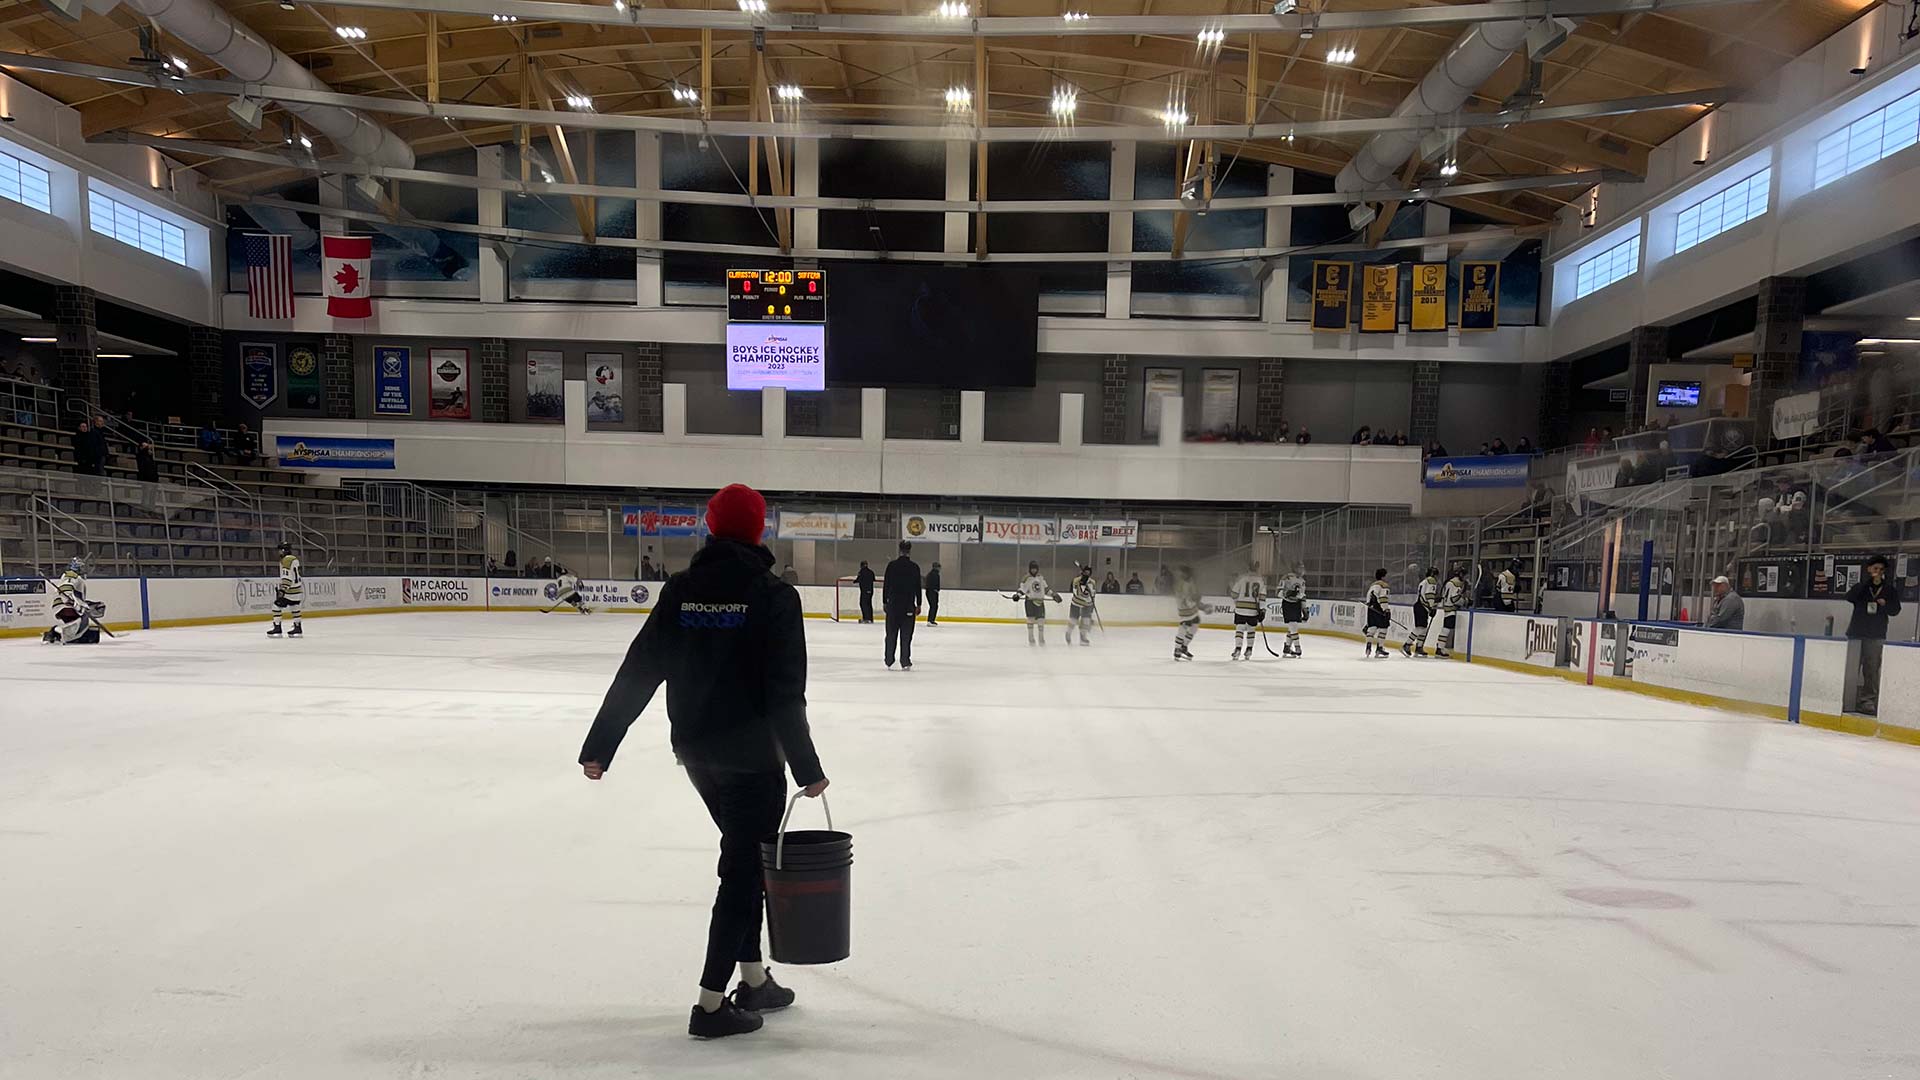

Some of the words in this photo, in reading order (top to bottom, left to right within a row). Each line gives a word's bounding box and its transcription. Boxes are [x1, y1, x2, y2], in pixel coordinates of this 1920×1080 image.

[765, 271, 792, 283] 12:00
[743, 281, 751, 292] 0
[779, 285, 786, 295] 0
[808, 281, 816, 292] 0
[768, 305, 775, 314] 0
[784, 305, 791, 314] 0
[1780, 332, 1788, 344] 2
[761, 346, 776, 354] ICE
[779, 346, 819, 354] HOCKEY
[733, 354, 819, 363] CHAMPIONSHIPS
[331, 449, 385, 457] CHAMPIONSHIPS
[786, 521, 828, 529] CHOCOLATE
[929, 523, 979, 533] NYSCOPBA
[986, 521, 1041, 538] nycm
[1078, 530, 1098, 540] BASE
[428, 580, 468, 590] CAROLL
[412, 592, 468, 601] HARDWOOD
[502, 588, 511, 596] ICE
[513, 588, 538, 596] HOCKEY
[603, 595, 628, 603] Sabres
[681, 603, 749, 613] BROCKPORT
